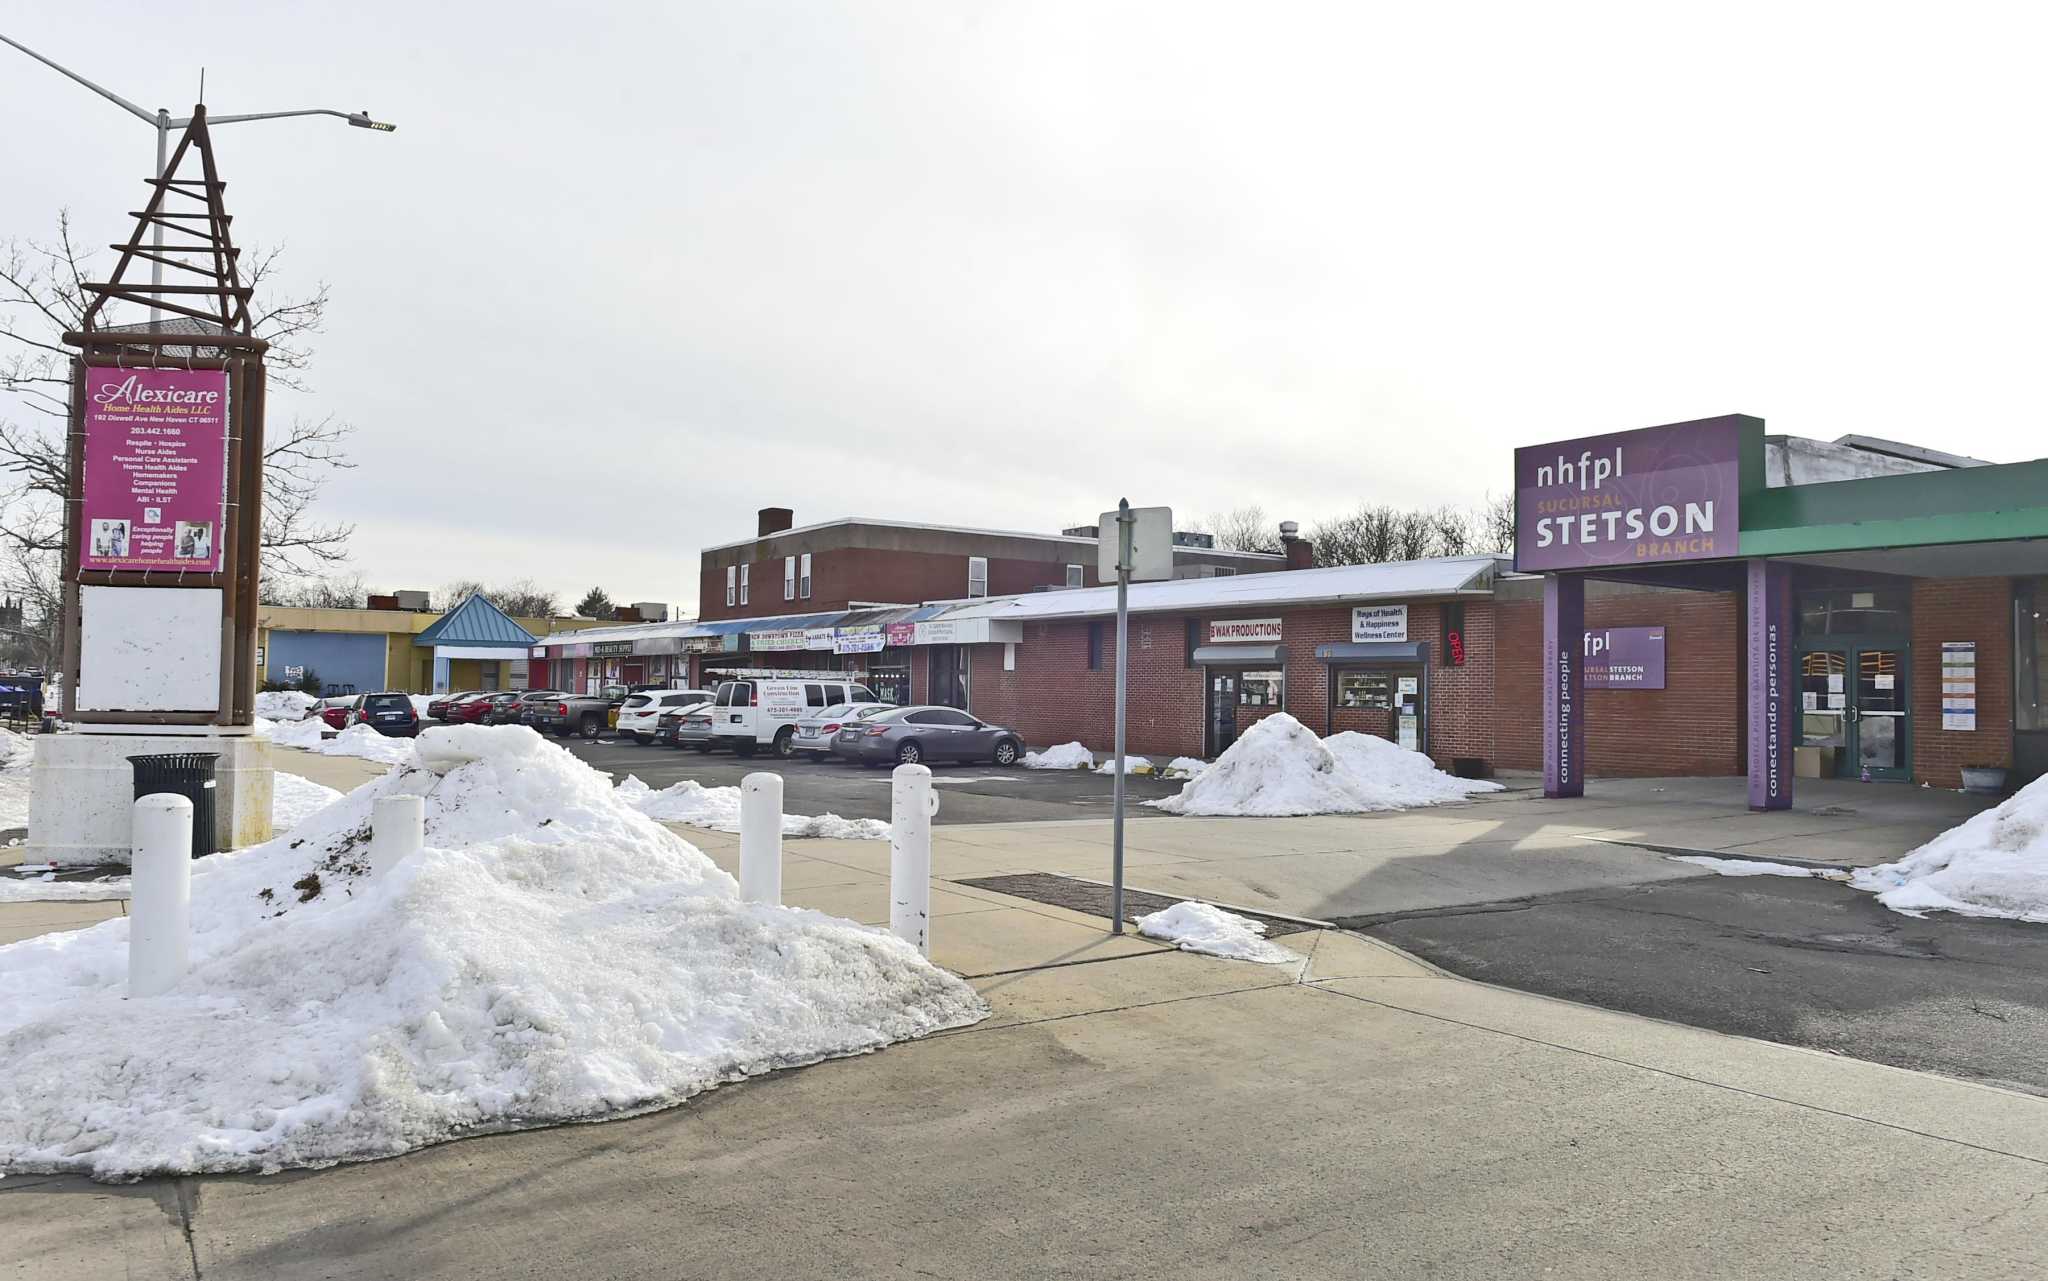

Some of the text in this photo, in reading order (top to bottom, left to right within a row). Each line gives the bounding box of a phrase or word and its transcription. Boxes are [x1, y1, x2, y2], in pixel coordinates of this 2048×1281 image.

[93, 375, 218, 404] Alexicare
[103, 403, 211, 414] Home Health Aides LLC
[162, 456, 198, 464] Assistants
[1537, 447, 1622, 491] nhfpl
[1536, 493, 1623, 514] SUCURSAL
[1536, 500, 1714, 548] STETSON
[1636, 537, 1714, 558] BRANCH
[1356, 608, 1403, 619] Rays of Health
[1231, 623, 1281, 637] PRODUCTIONS
[1366, 621, 1399, 629] Happiness
[1382, 631, 1405, 639] Center
[1447, 632, 1465, 666] OPEN
[1584, 631, 1610, 656] fpl
[1609, 665, 1644, 673] STETSON
[1559, 651, 1571, 784] connecting people
[1768, 624, 1778, 797] conectando personas
